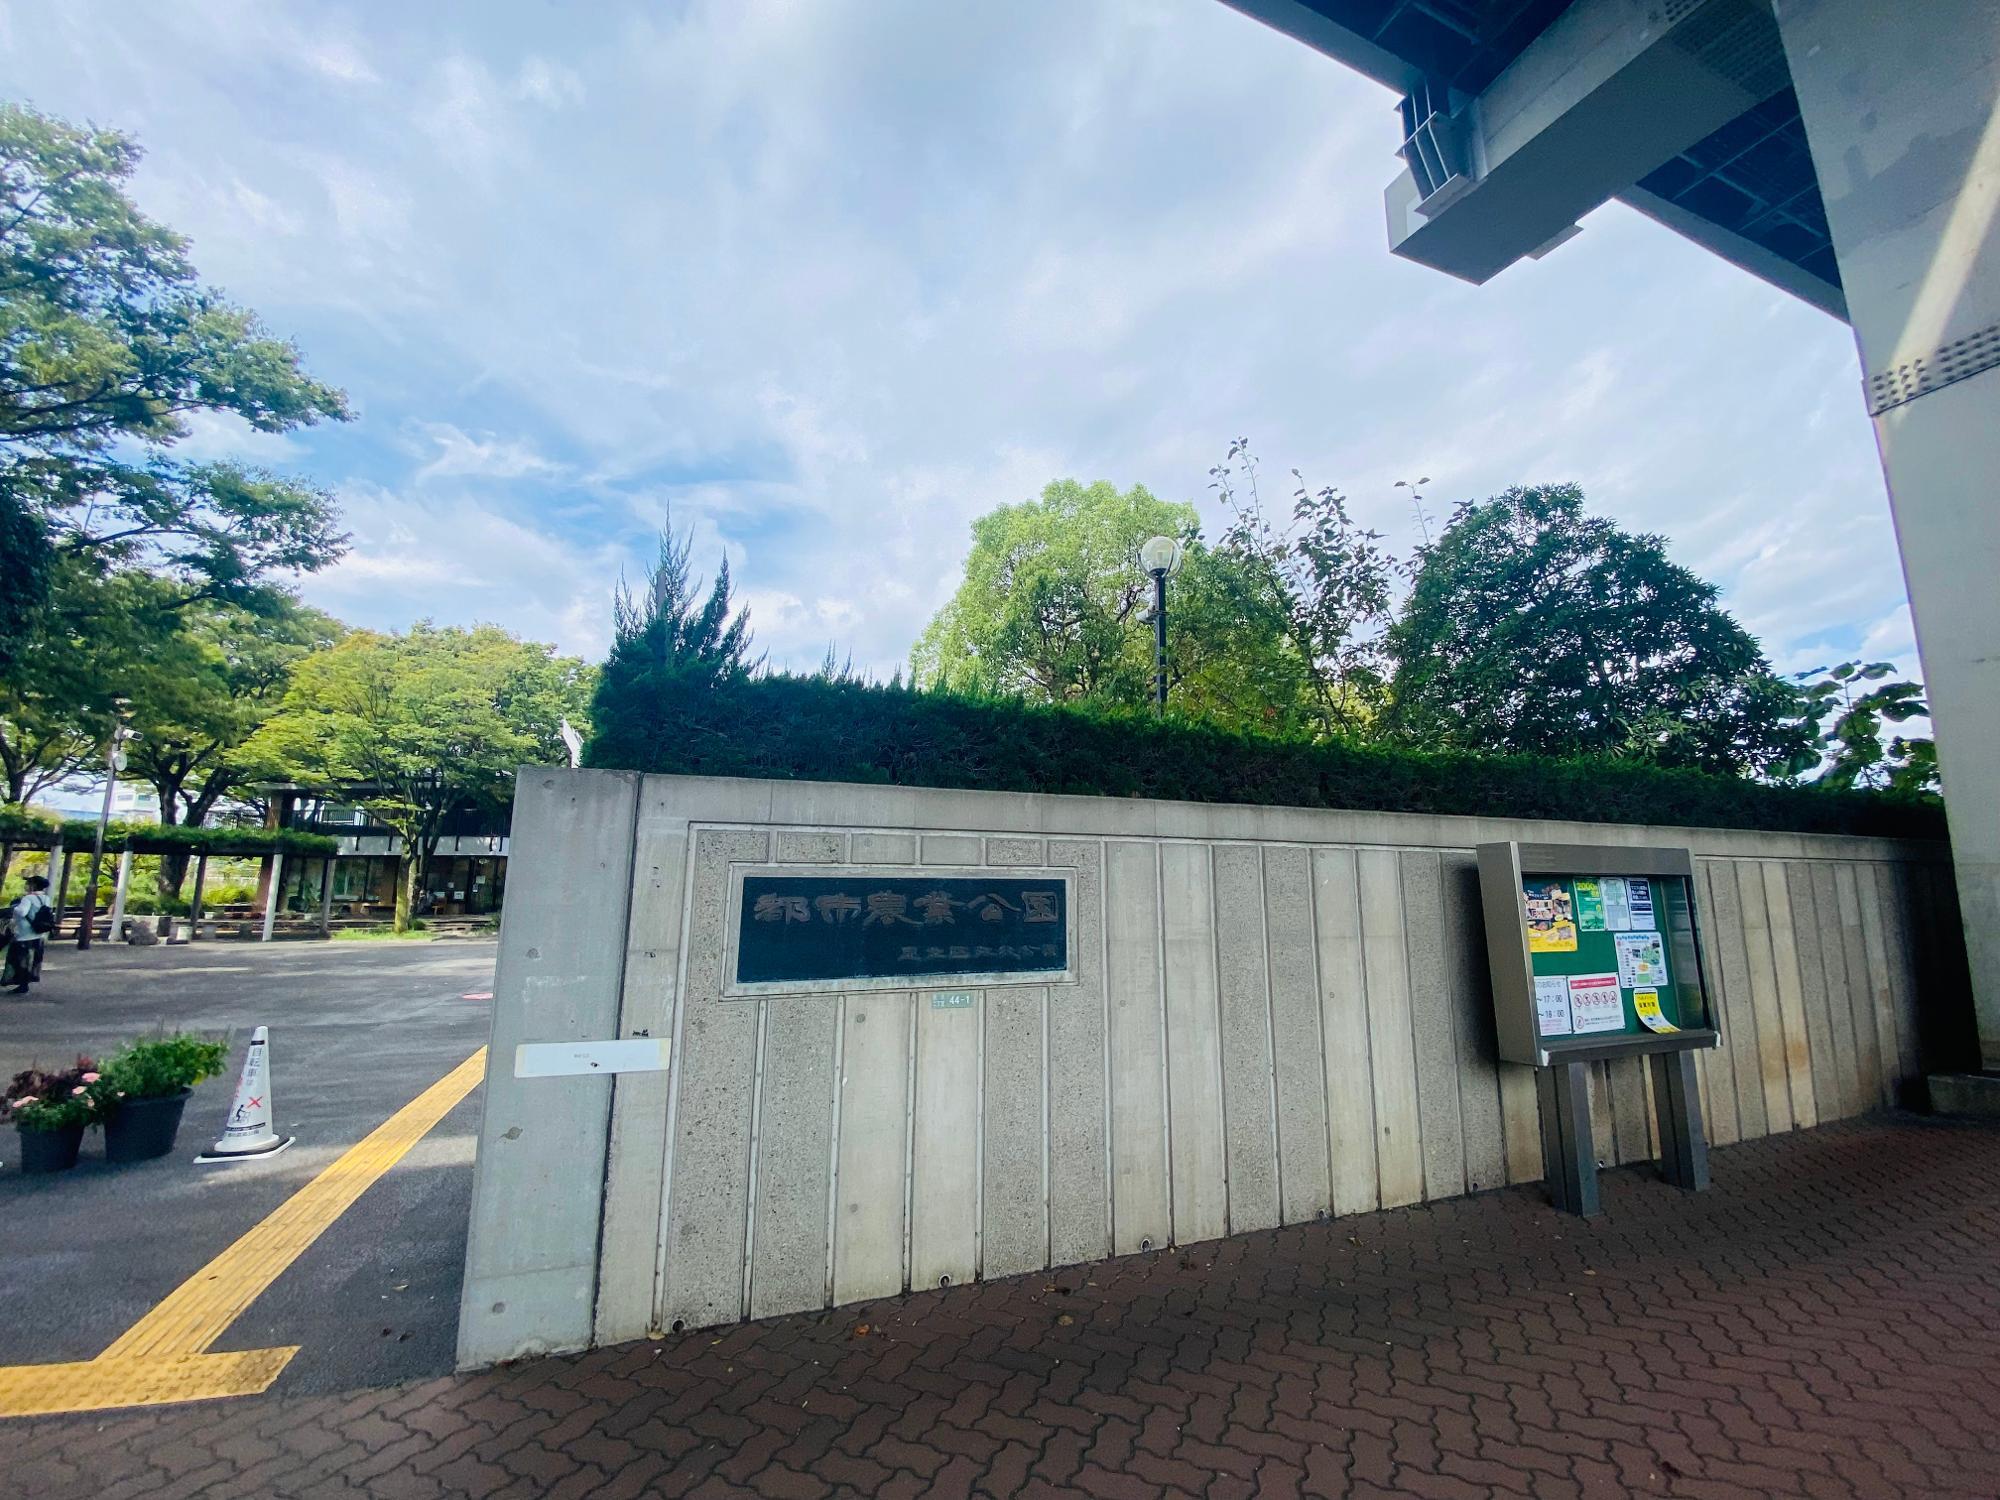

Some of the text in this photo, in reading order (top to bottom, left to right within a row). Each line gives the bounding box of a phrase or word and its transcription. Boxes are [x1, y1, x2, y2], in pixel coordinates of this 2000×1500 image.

[754, 889, 1059, 924] 都市農業公園
[949, 995, 970, 1004] 44-1
